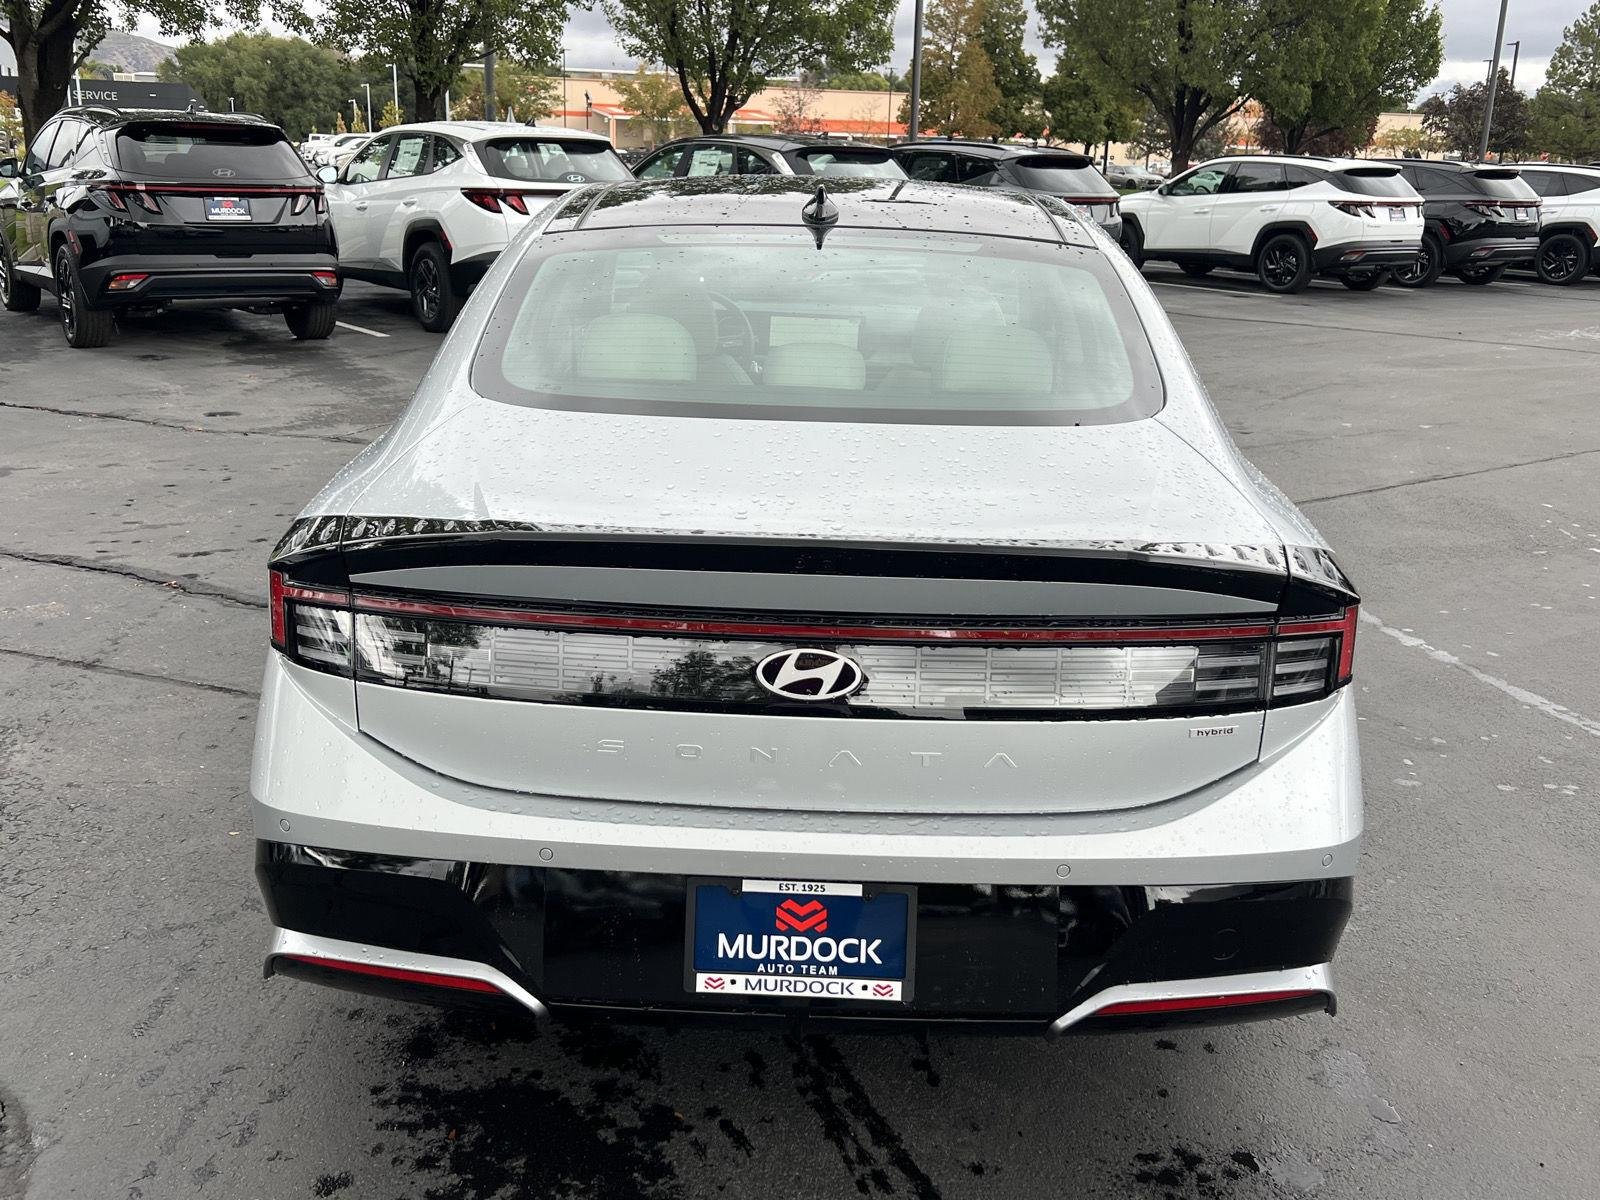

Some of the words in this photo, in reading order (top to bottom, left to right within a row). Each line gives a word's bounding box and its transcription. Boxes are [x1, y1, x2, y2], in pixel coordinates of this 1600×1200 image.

[72, 90, 118, 101] SERVICE
[1197, 727, 1234, 737] hybrid
[597, 738, 1018, 769] SONATA
[778, 883, 800, 892] EST.
[802, 884, 826, 893] 1925
[717, 932, 883, 965] MURDOCK
[757, 963, 794, 974] AUTO
[801, 964, 838, 976] TEAM
[744, 977, 855, 996] MURDOCK
